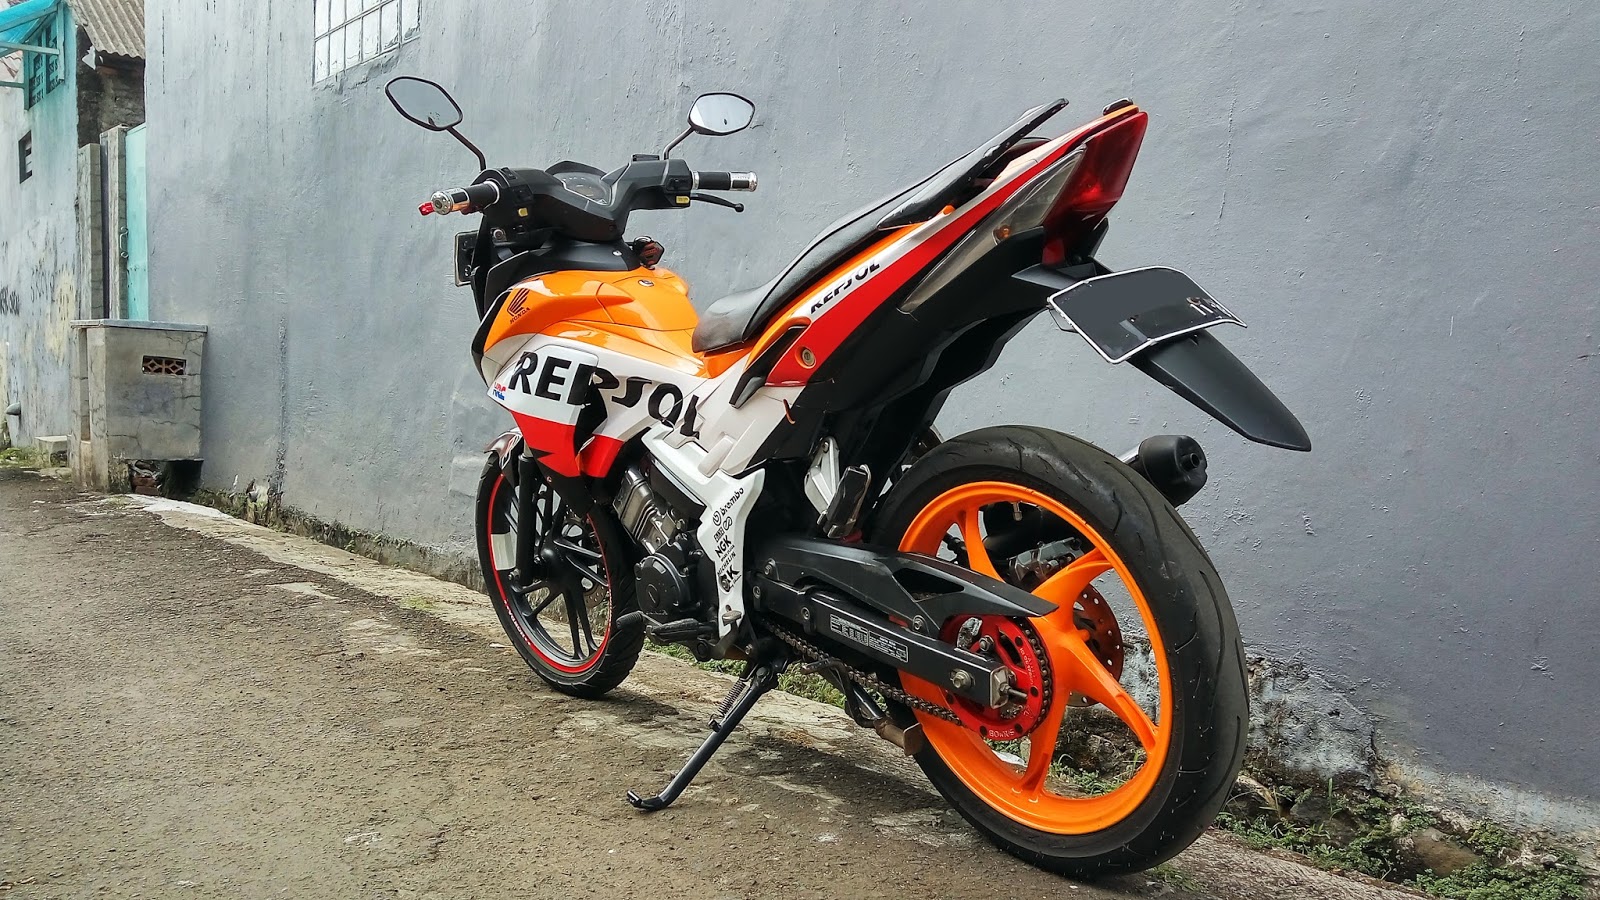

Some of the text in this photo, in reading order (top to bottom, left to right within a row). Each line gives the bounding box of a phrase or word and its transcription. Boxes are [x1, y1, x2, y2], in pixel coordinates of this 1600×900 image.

[510, 306, 531, 324] HONDA
[508, 351, 700, 440] REPSOL
[720, 487, 744, 516] brembo
[715, 534, 732, 558] NGK
[717, 551, 736, 576] MICHELIN
